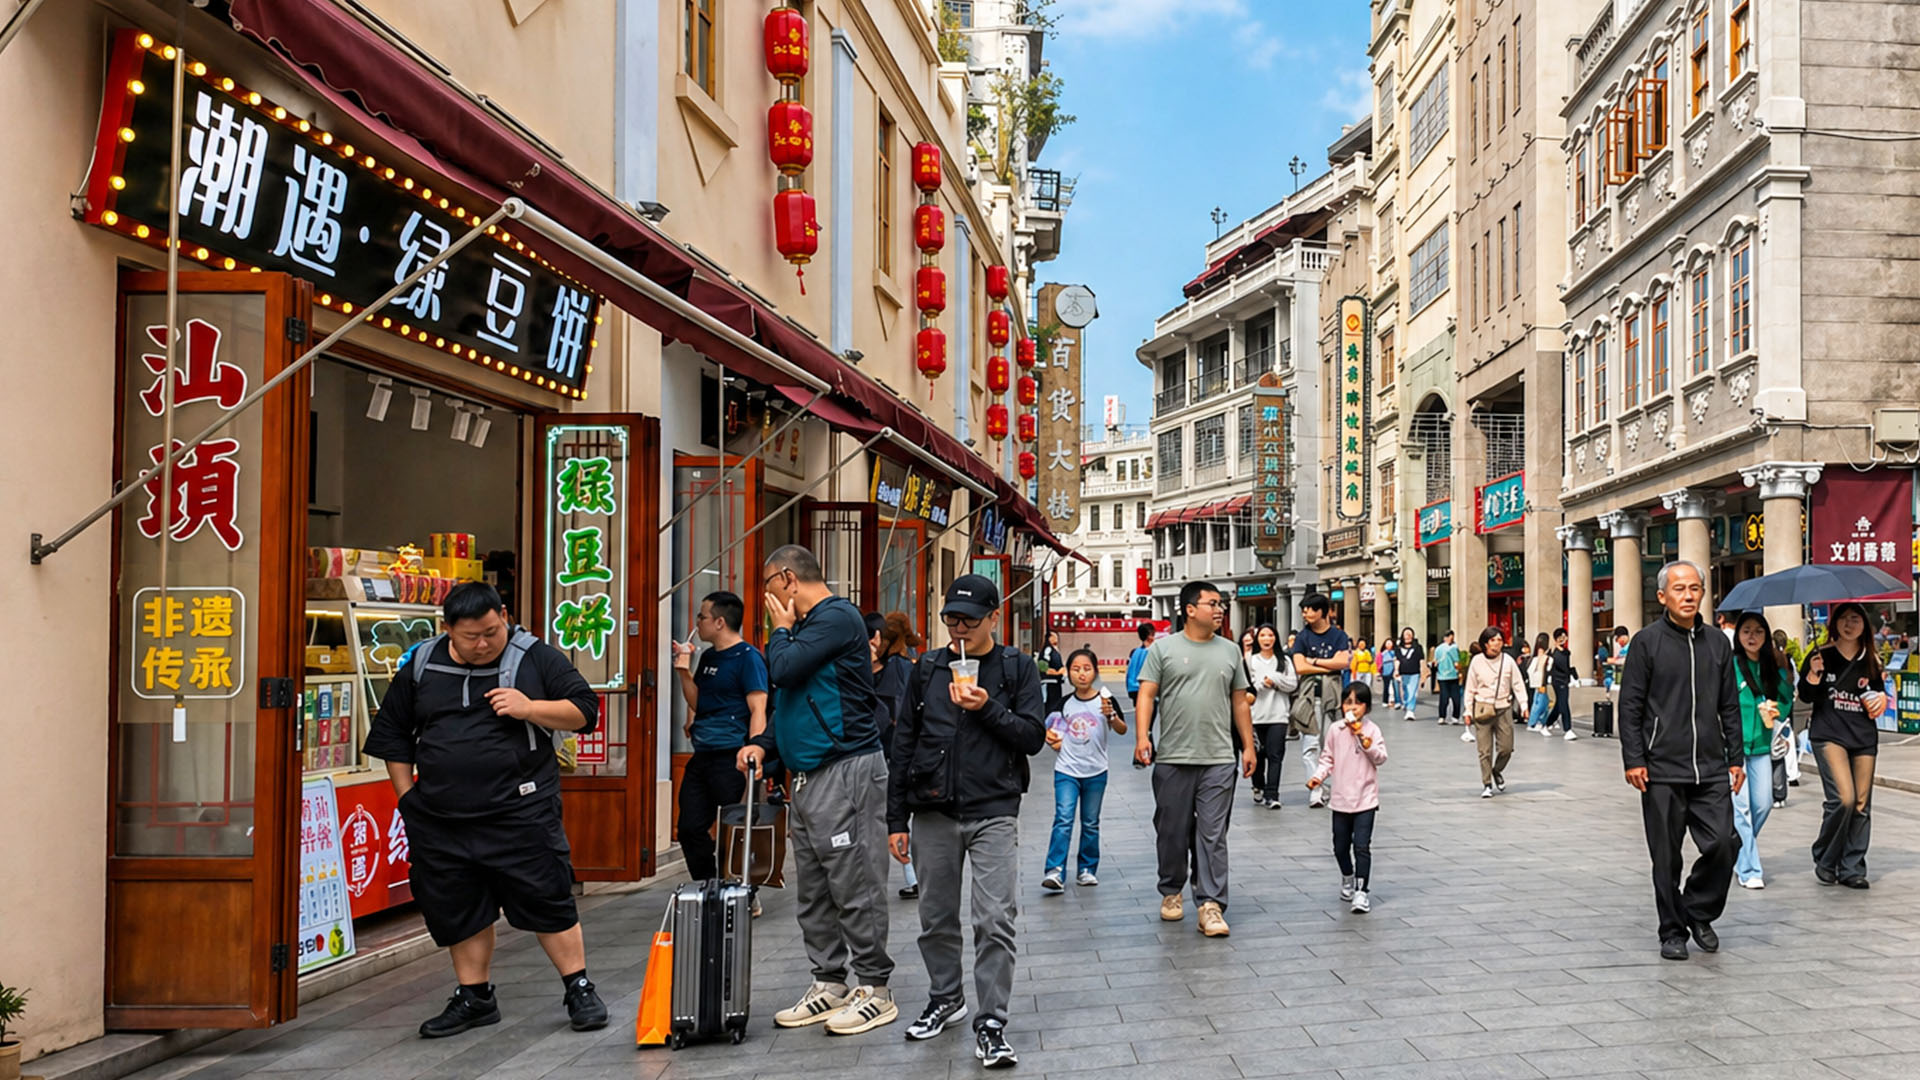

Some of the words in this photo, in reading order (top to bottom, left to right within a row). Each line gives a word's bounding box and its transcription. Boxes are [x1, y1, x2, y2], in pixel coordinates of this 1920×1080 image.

[178, 91, 590, 378] 潮遇·绿豆饼
[142, 595, 234, 638] 非遗
[142, 646, 233, 690] 传承
